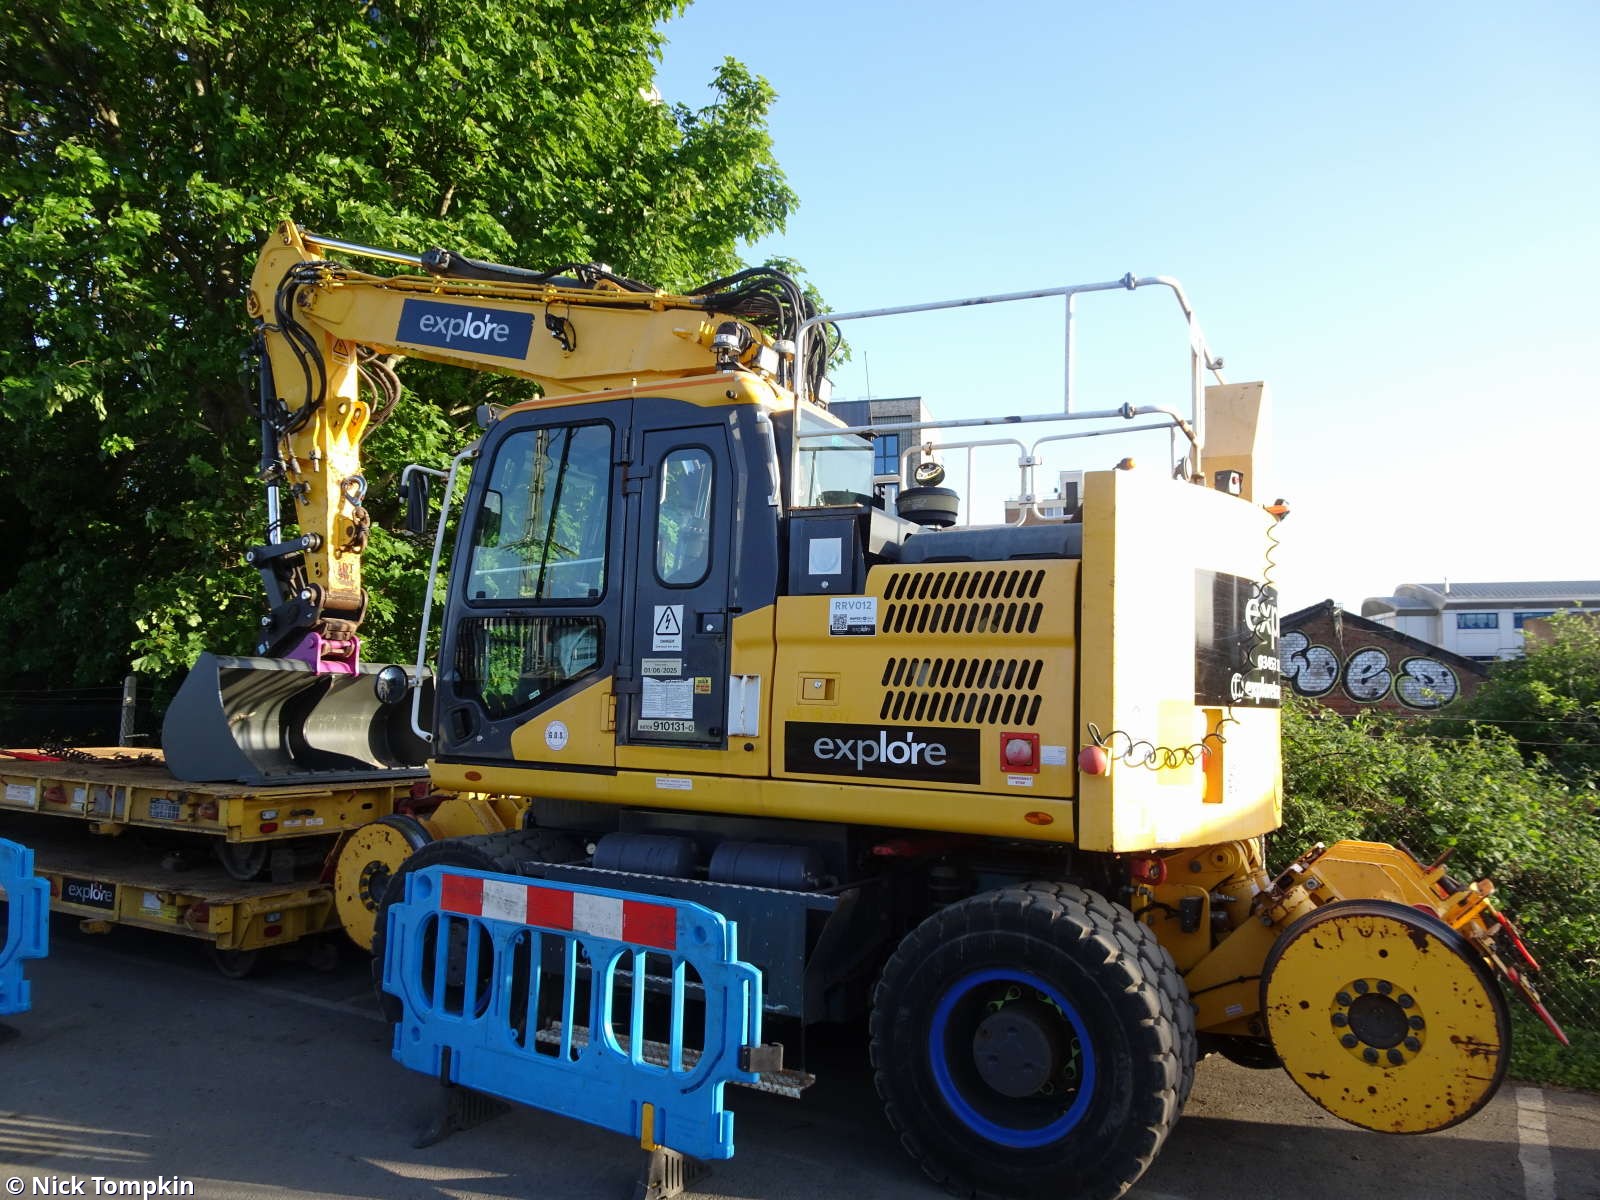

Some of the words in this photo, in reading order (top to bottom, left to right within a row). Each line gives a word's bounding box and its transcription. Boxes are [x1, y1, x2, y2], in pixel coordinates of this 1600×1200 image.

[419, 311, 510, 343] explore
[835, 601, 872, 610] RRV012
[813, 730, 947, 771] explore
[68, 883, 113, 902] explore
